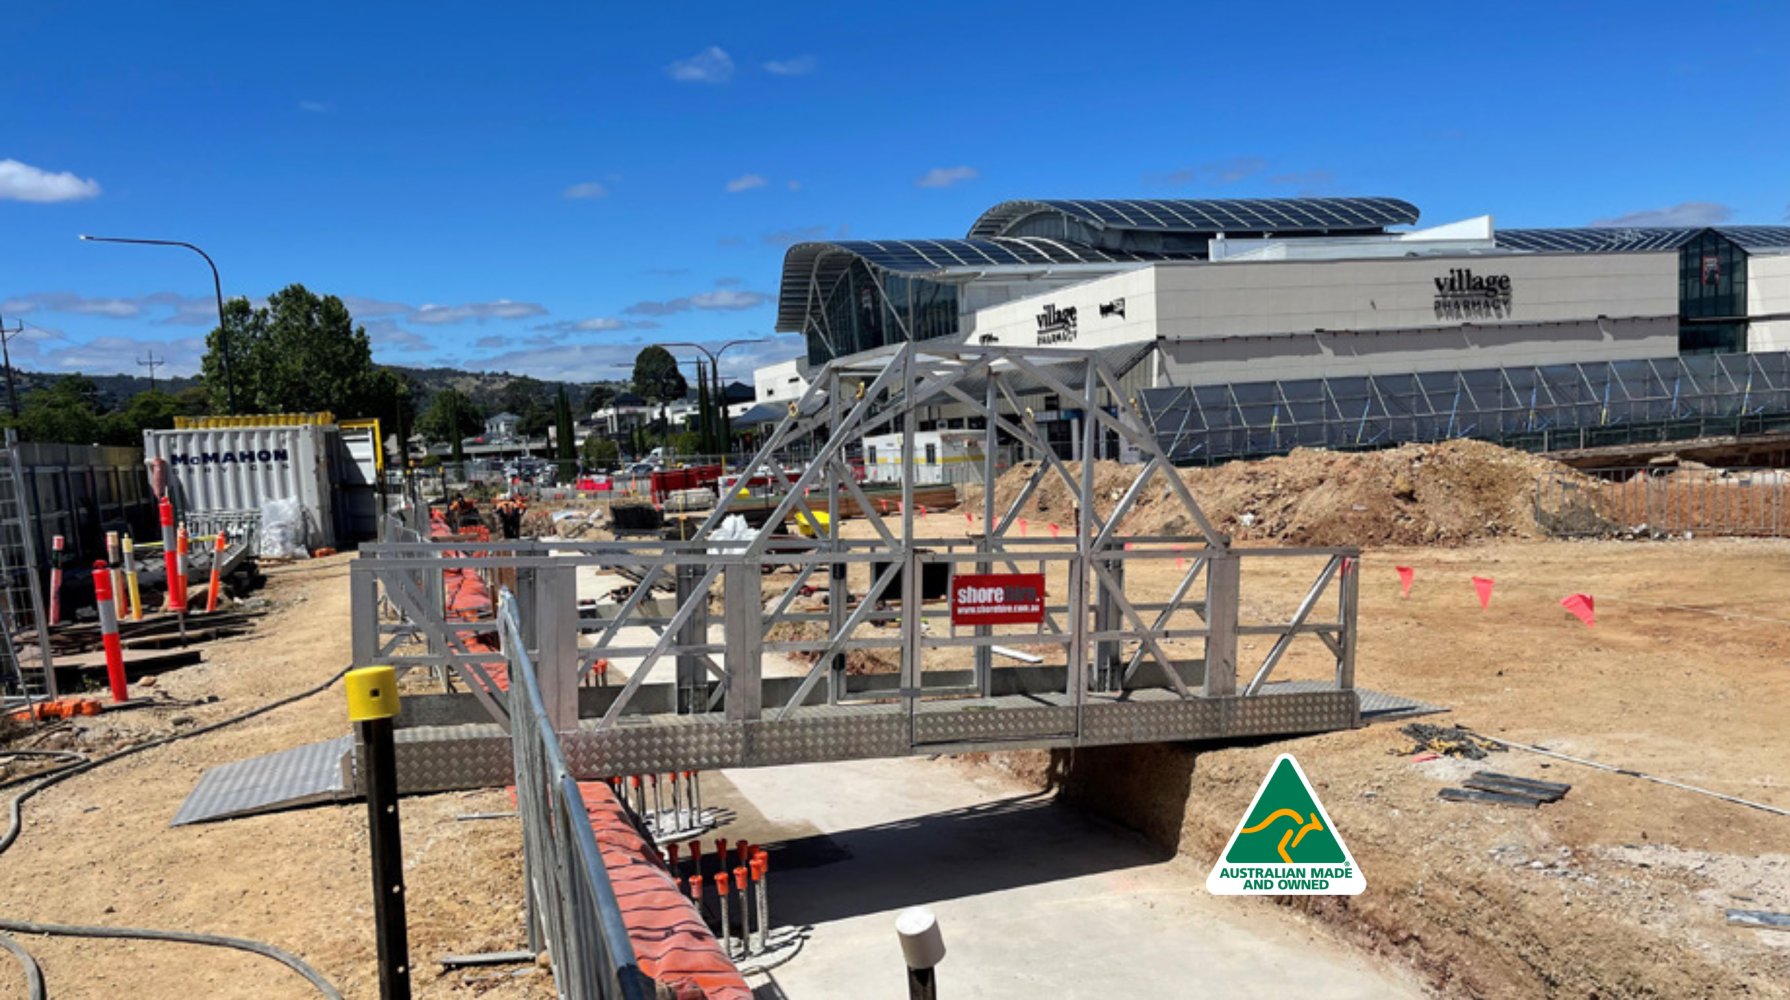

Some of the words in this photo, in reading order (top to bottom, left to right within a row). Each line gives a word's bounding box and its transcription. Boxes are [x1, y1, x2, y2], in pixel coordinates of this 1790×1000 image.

[1434, 267, 1511, 298] village
[1434, 299, 1510, 311] PHARMACY
[1036, 303, 1077, 330] village
[171, 449, 288, 465] McMAHON
